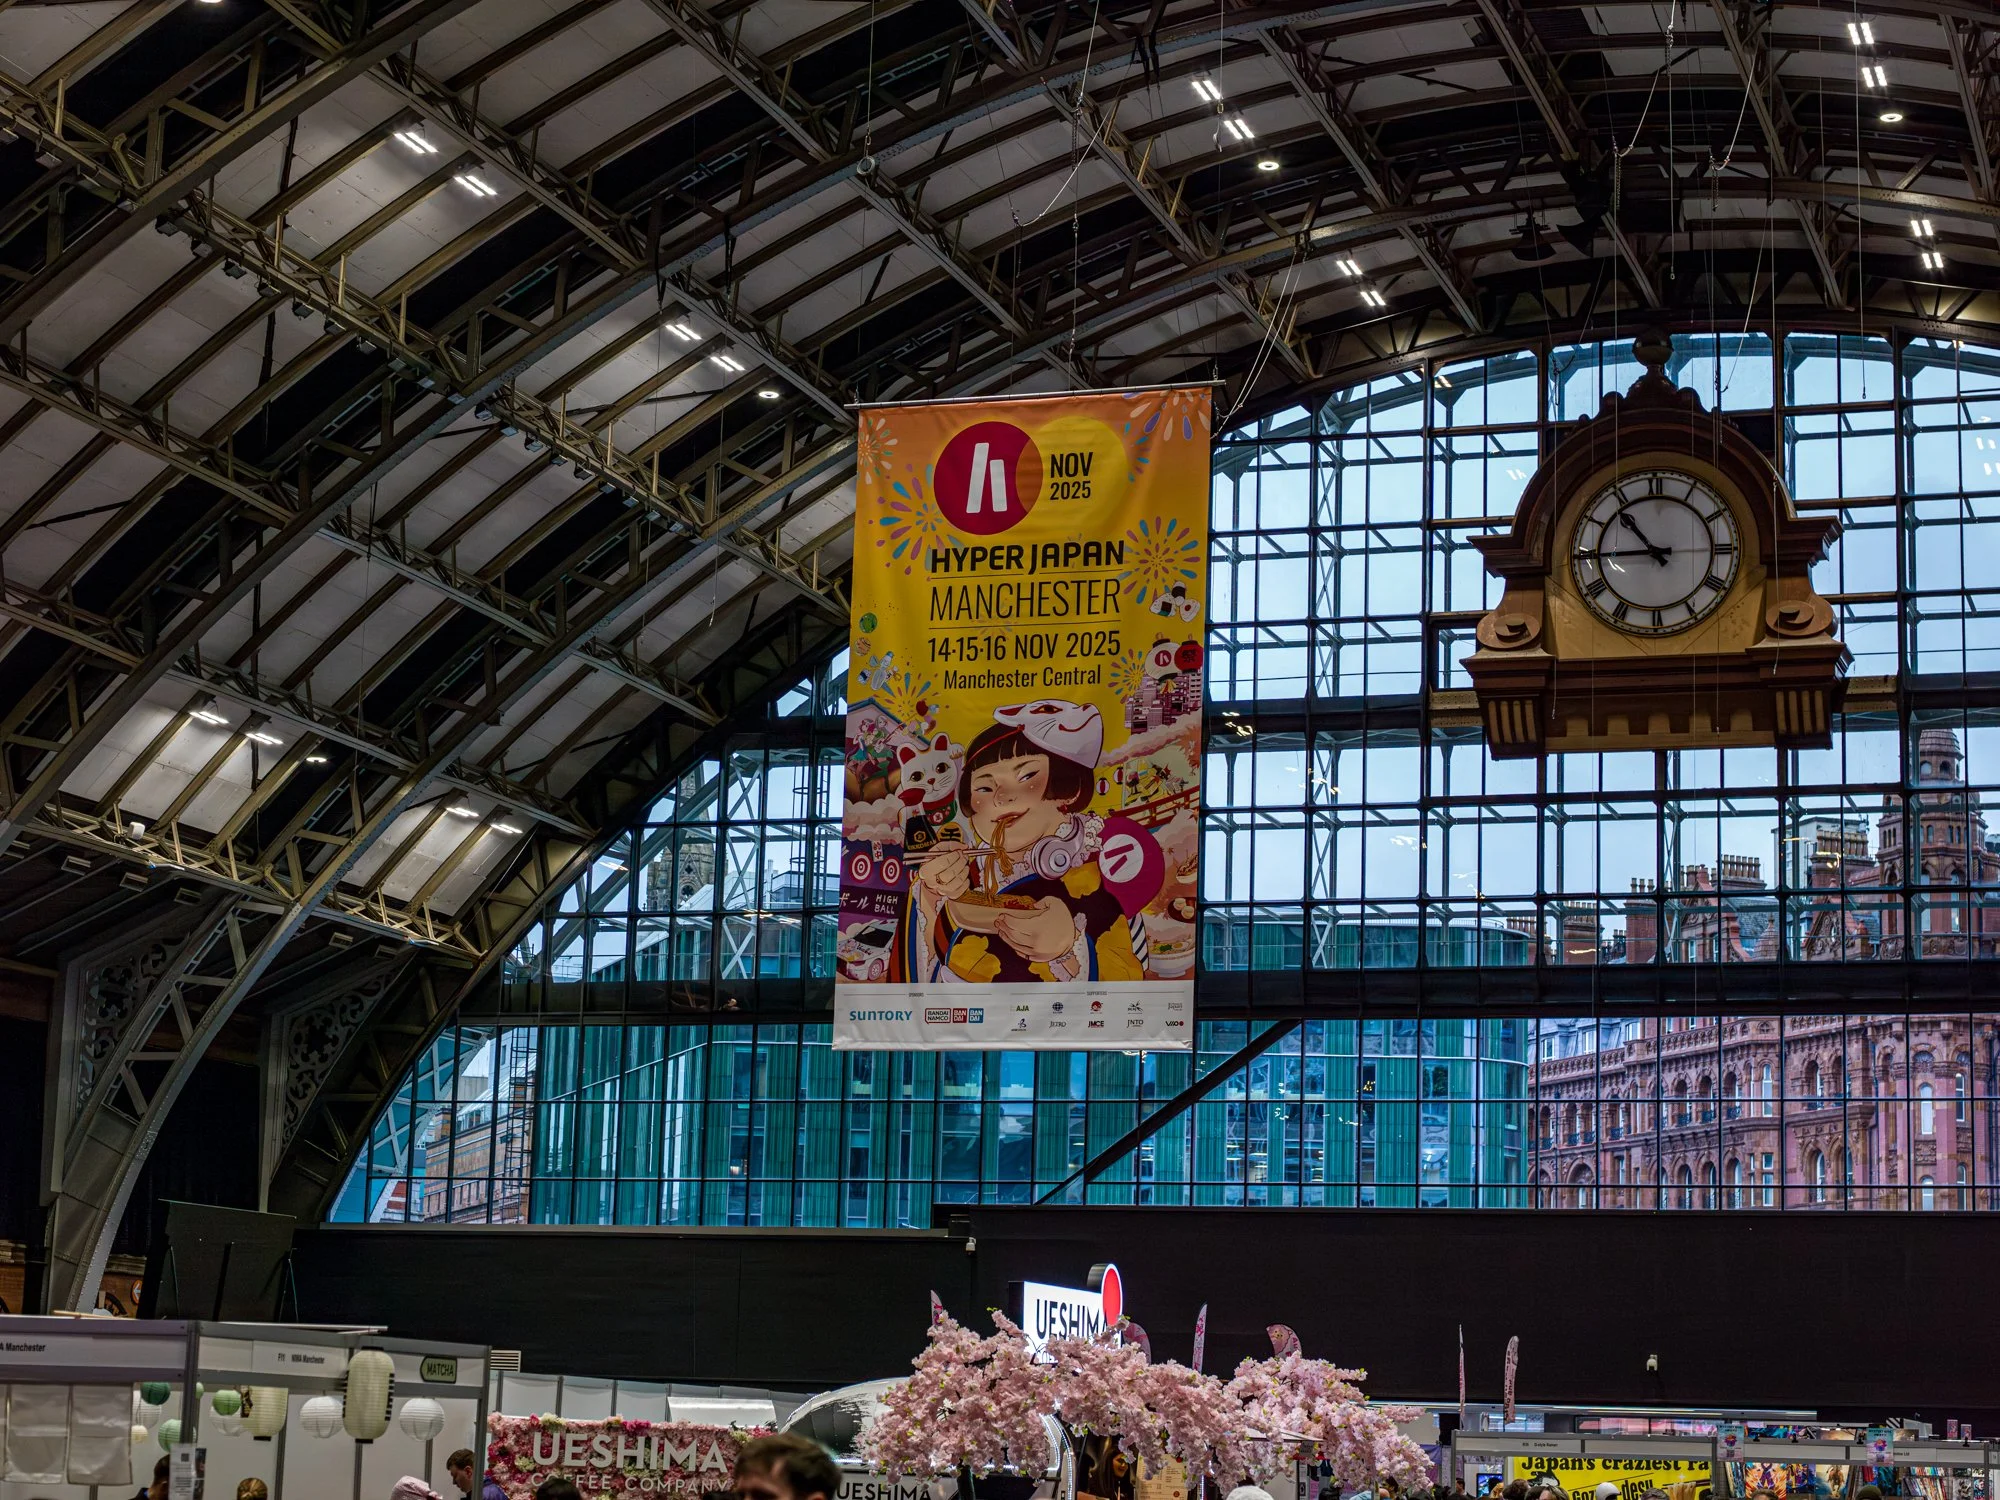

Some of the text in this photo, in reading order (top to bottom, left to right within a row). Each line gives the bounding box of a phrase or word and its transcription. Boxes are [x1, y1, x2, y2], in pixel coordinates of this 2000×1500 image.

[1050, 452, 1093, 478] NOV
[1050, 481, 1091, 500] 2025
[931, 540, 1125, 574] HYPER JAPAN
[930, 578, 1120, 621] MANCHESTER
[1015, 633, 1058, 660] NOV
[1066, 630, 1121, 657] 2025
[943, 665, 1101, 690] Manchester Central
[874, 904, 895, 915] BALL
[876, 894, 898, 905] HIGH
[6, 1342, 46, 1352] Manchester
[427, 1363, 454, 1377] MATCHA
[533, 1432, 728, 1473] UESHIMA
[1521, 1456, 1595, 1471] Japan's
[1601, 1458, 1680, 1471] craziest
[531, 1473, 727, 1493] CFEE COMPANY
